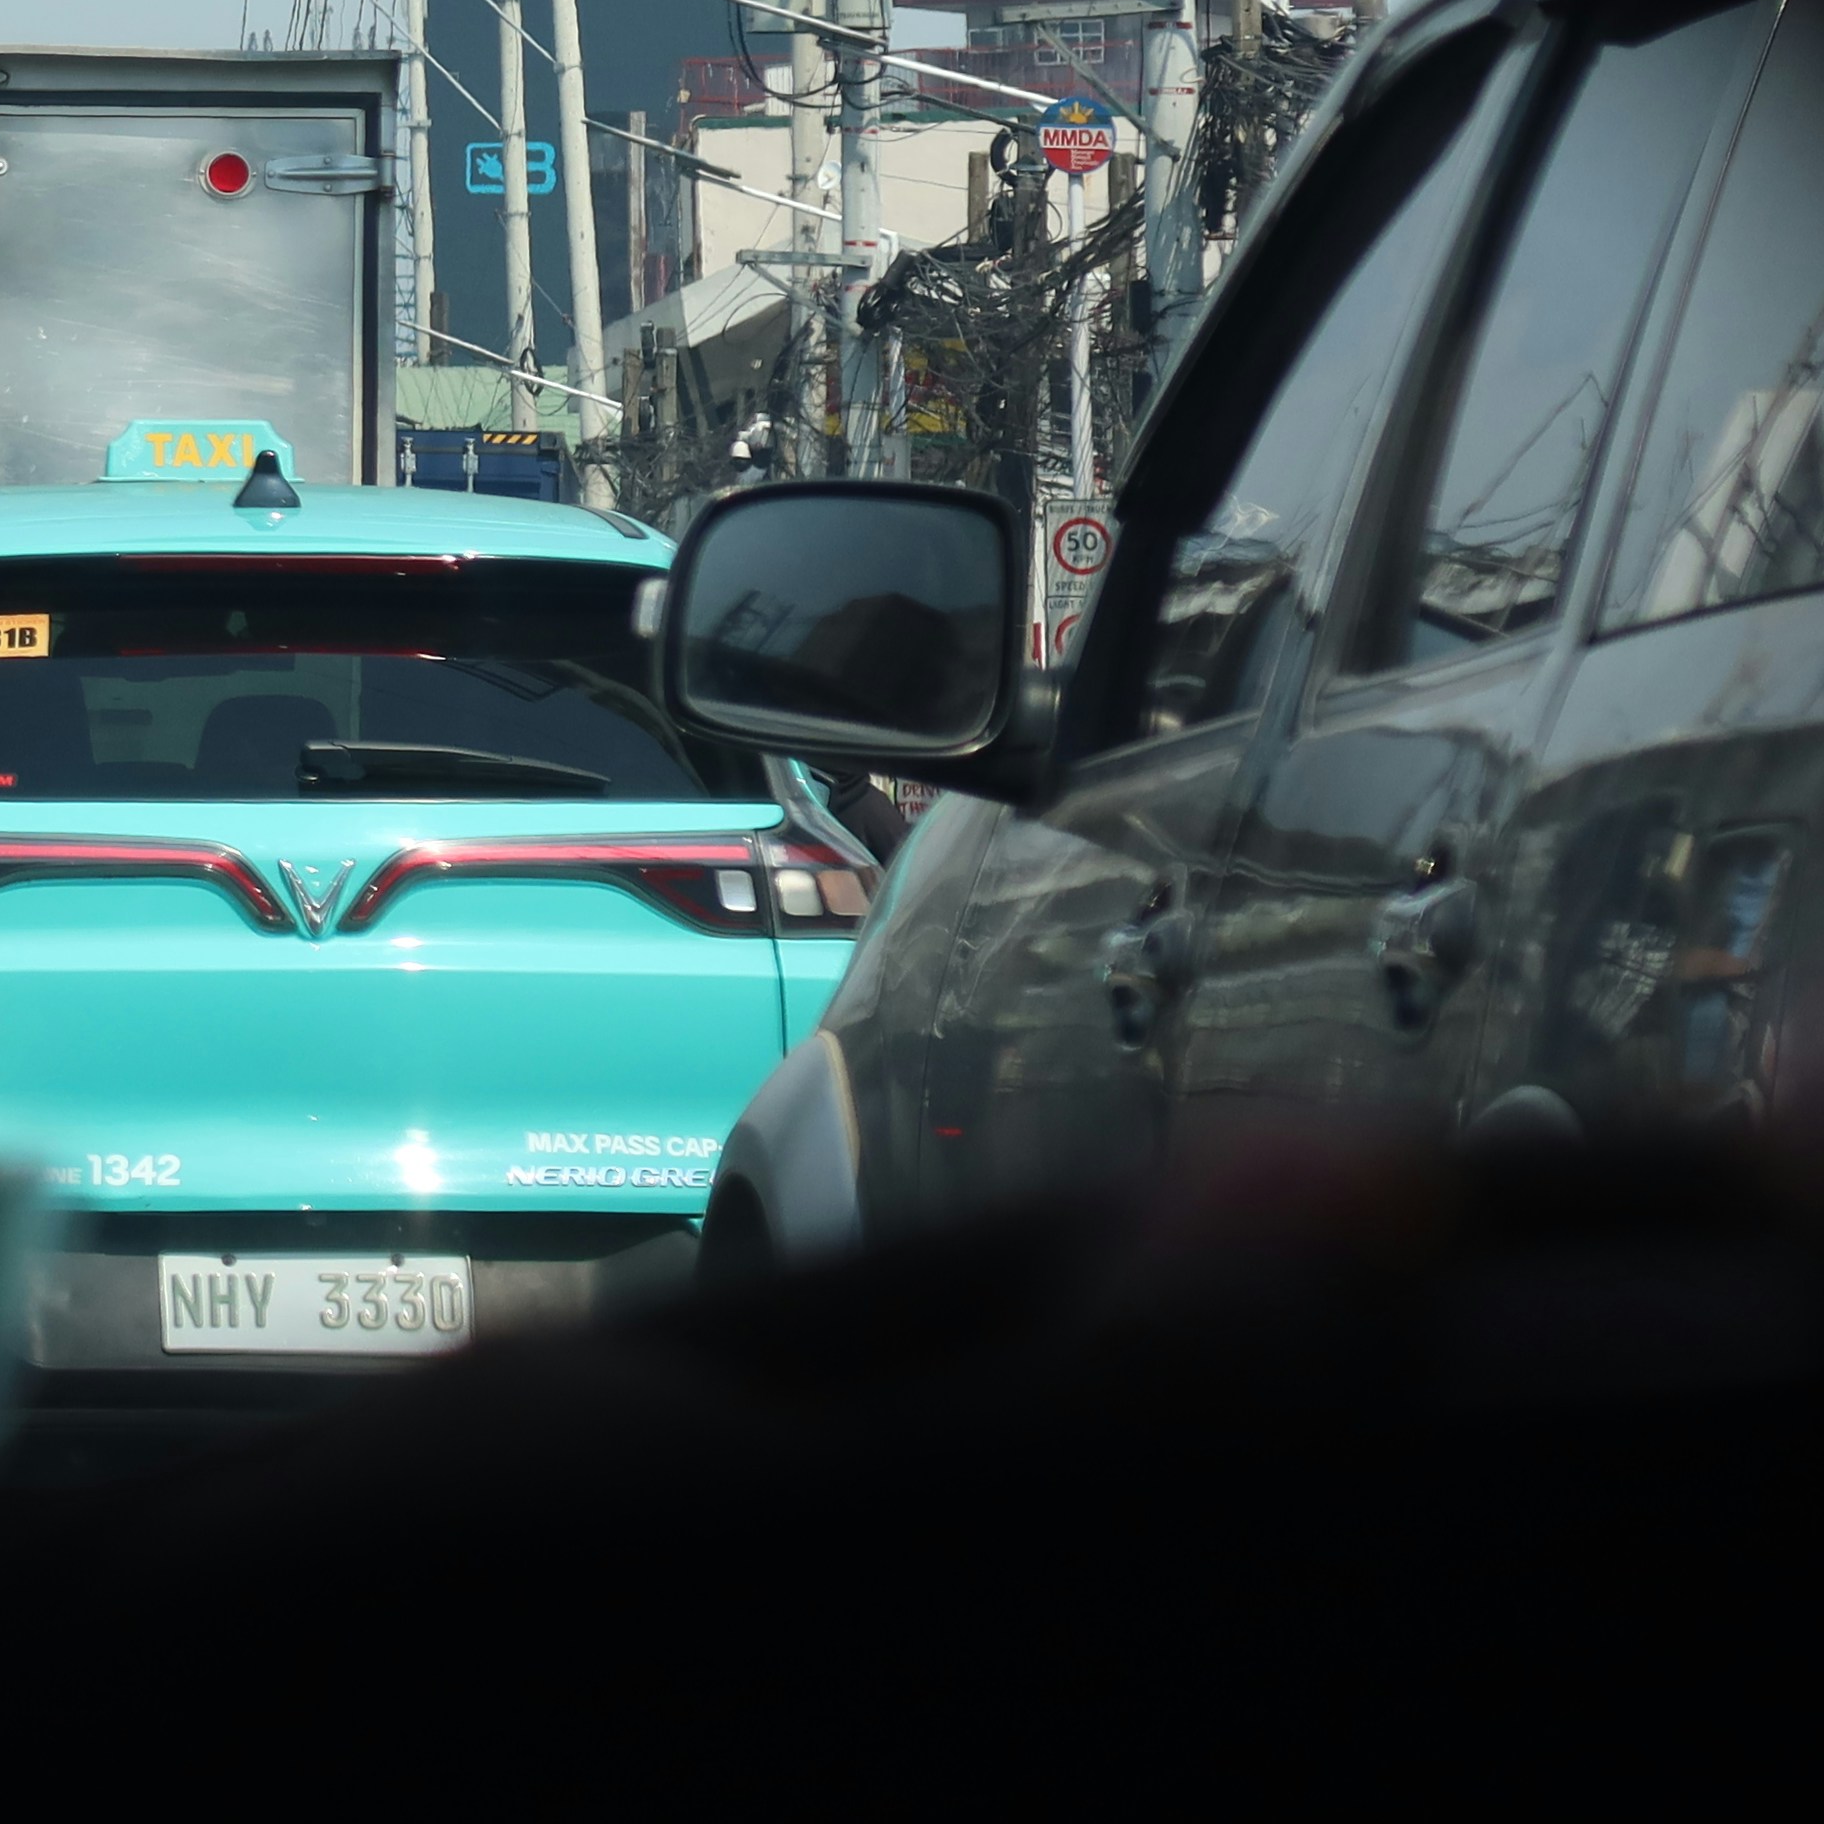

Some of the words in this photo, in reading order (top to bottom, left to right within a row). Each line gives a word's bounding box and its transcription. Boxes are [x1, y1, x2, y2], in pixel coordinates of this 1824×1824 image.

[1043, 128, 1109, 147] MMDA
[145, 432, 255, 468] TAXI
[1067, 531, 1098, 552] 50
[1055, 581, 1086, 592] SPEED
[527, 1132, 590, 1153] MAX
[595, 1133, 661, 1156] PASS
[86, 1153, 182, 1186] 1342
[507, 1165, 627, 1188] NERIO
[170, 1272, 276, 1328] NHY
[318, 1271, 465, 1332] 3330
